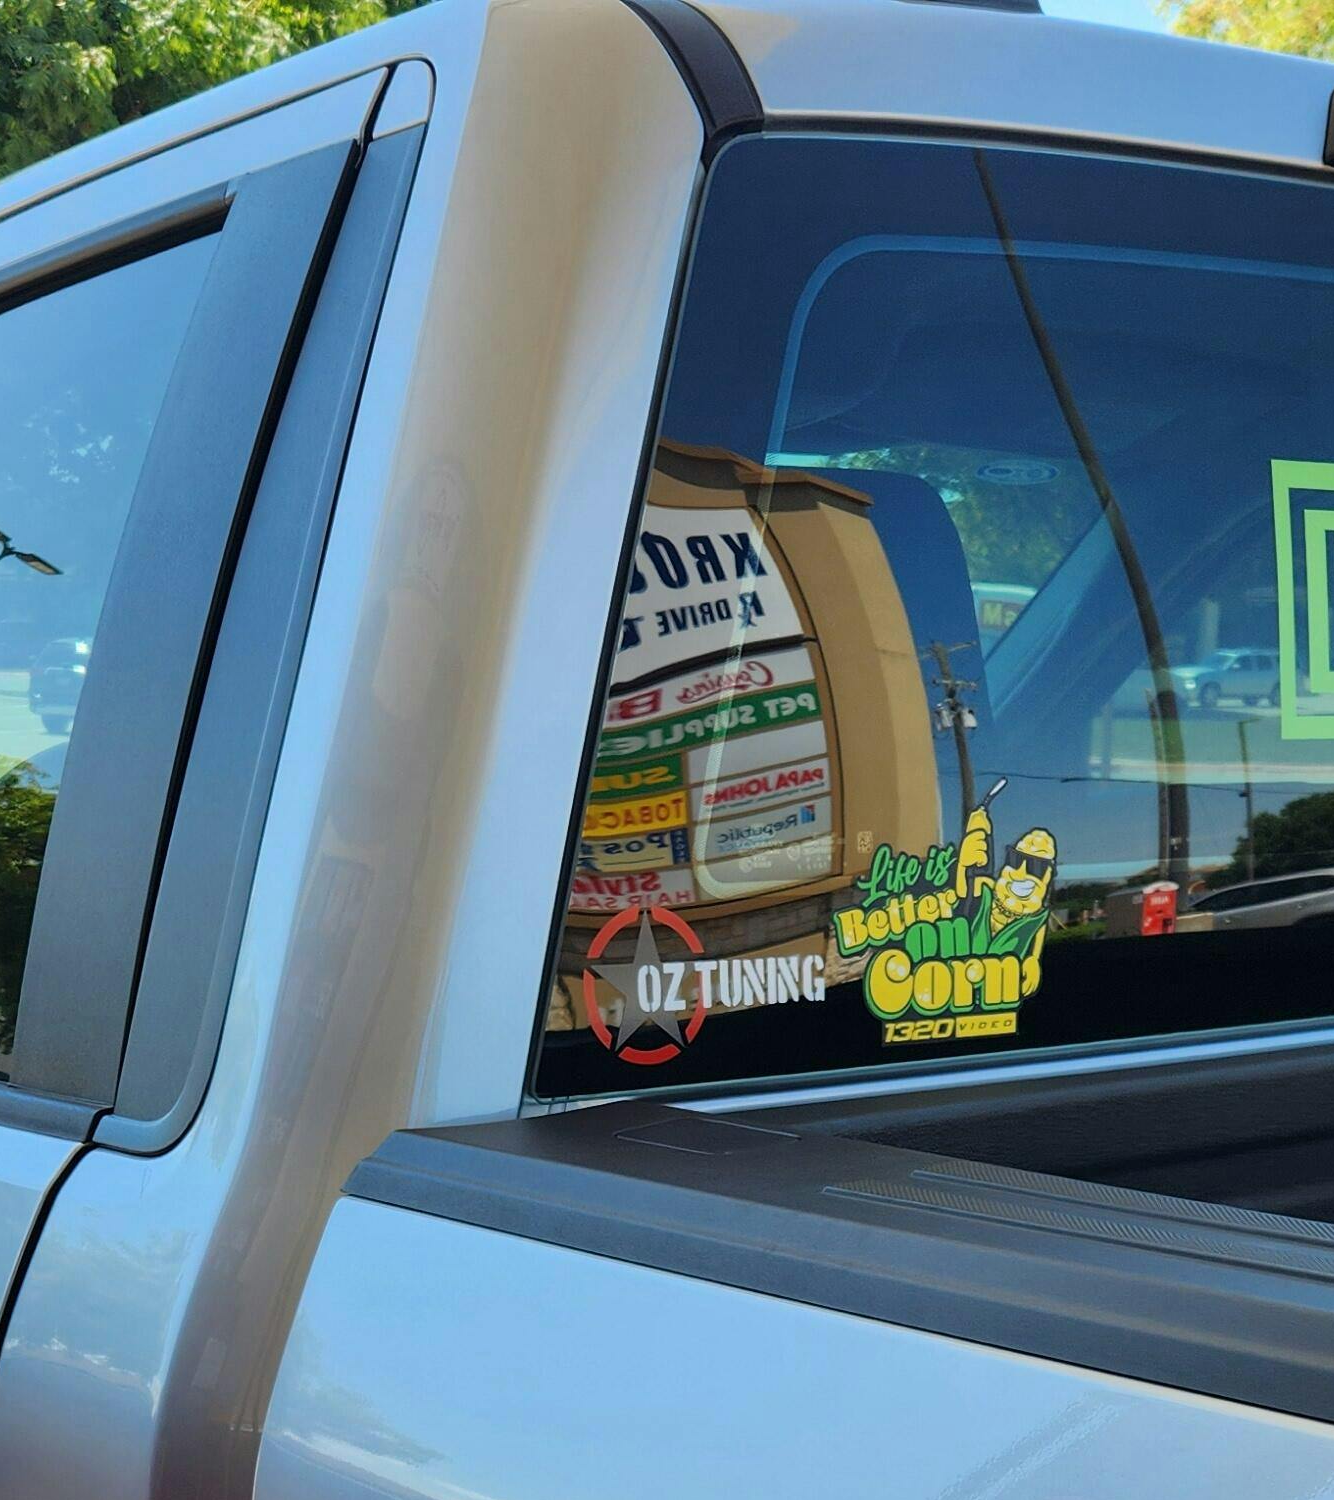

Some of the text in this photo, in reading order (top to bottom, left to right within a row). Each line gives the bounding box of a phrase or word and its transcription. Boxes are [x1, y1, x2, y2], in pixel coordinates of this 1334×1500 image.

[857, 844, 923, 909] Life
[925, 842, 957, 886] is
[835, 887, 959, 952] Better
[906, 917, 970, 962] on
[637, 953, 826, 1014] OZ TUNING
[868, 948, 1021, 1016] Corn
[884, 1017, 1014, 1043] 1320 VIDEO
